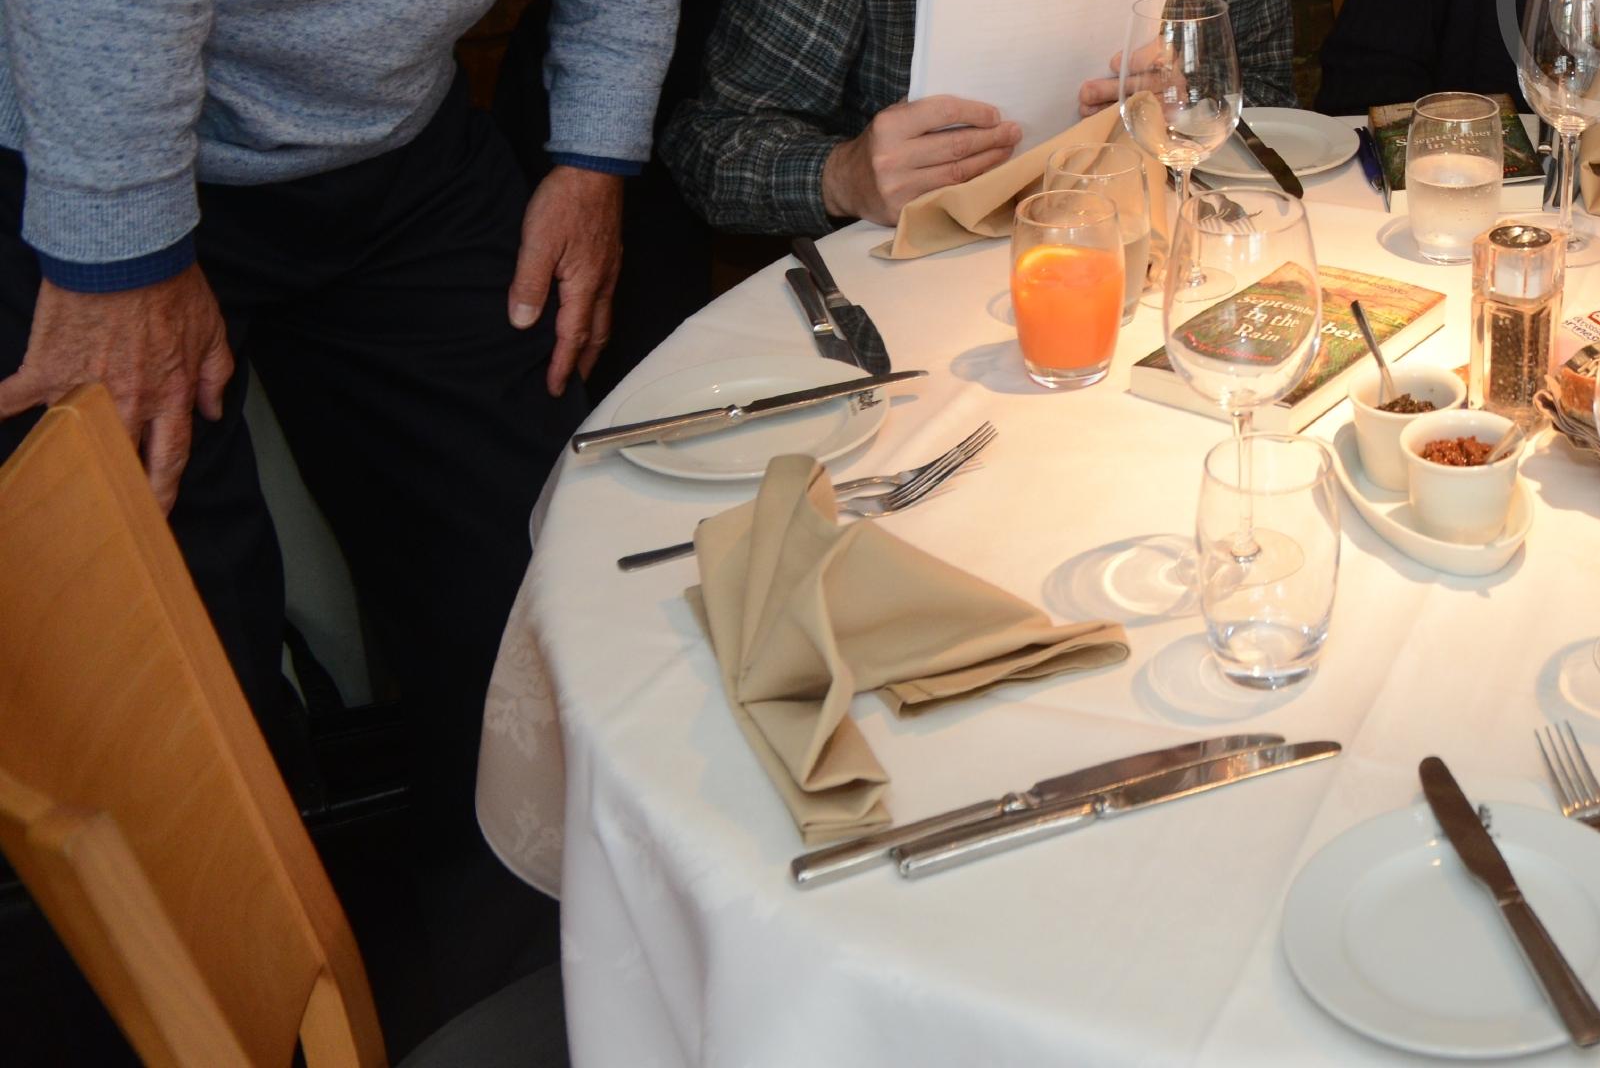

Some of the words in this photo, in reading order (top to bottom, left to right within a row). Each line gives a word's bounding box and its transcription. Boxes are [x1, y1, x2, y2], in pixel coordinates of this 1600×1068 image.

[1243, 307, 1268, 322] in
[1270, 310, 1299, 328] the
[1234, 323, 1280, 342] Rain
